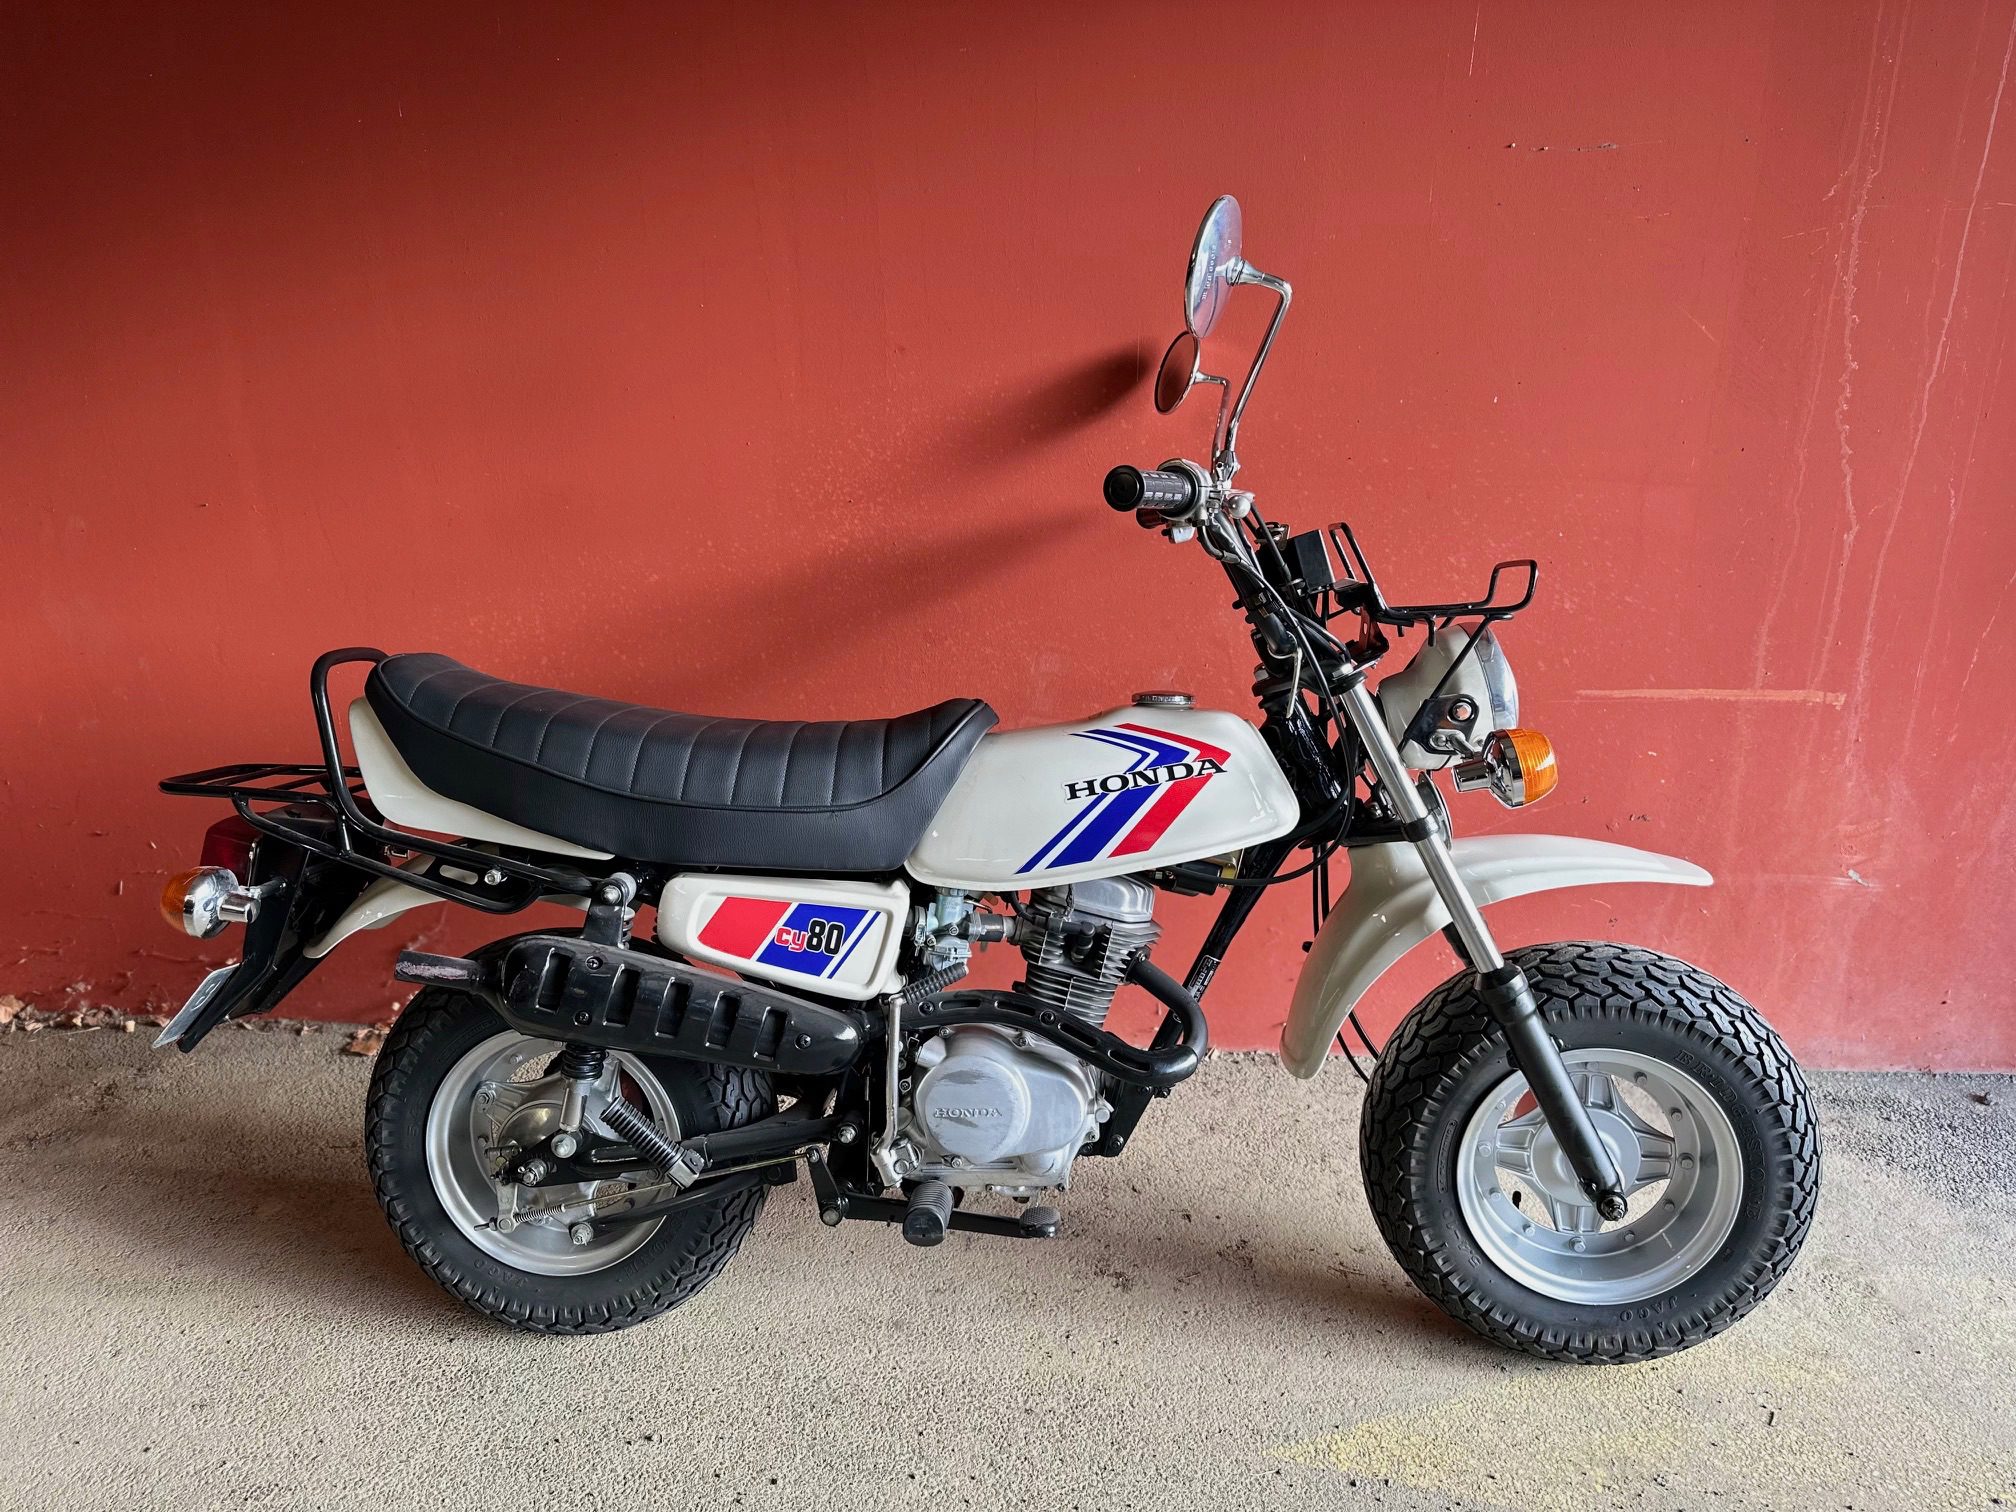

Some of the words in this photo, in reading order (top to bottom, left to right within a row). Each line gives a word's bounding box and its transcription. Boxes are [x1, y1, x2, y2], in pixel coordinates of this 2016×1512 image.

[1064, 758, 1228, 801] HONDA
[775, 918, 845, 956] cy80
[933, 1107, 1003, 1118] HONDA
[1619, 1295, 1679, 1323] JAGO
